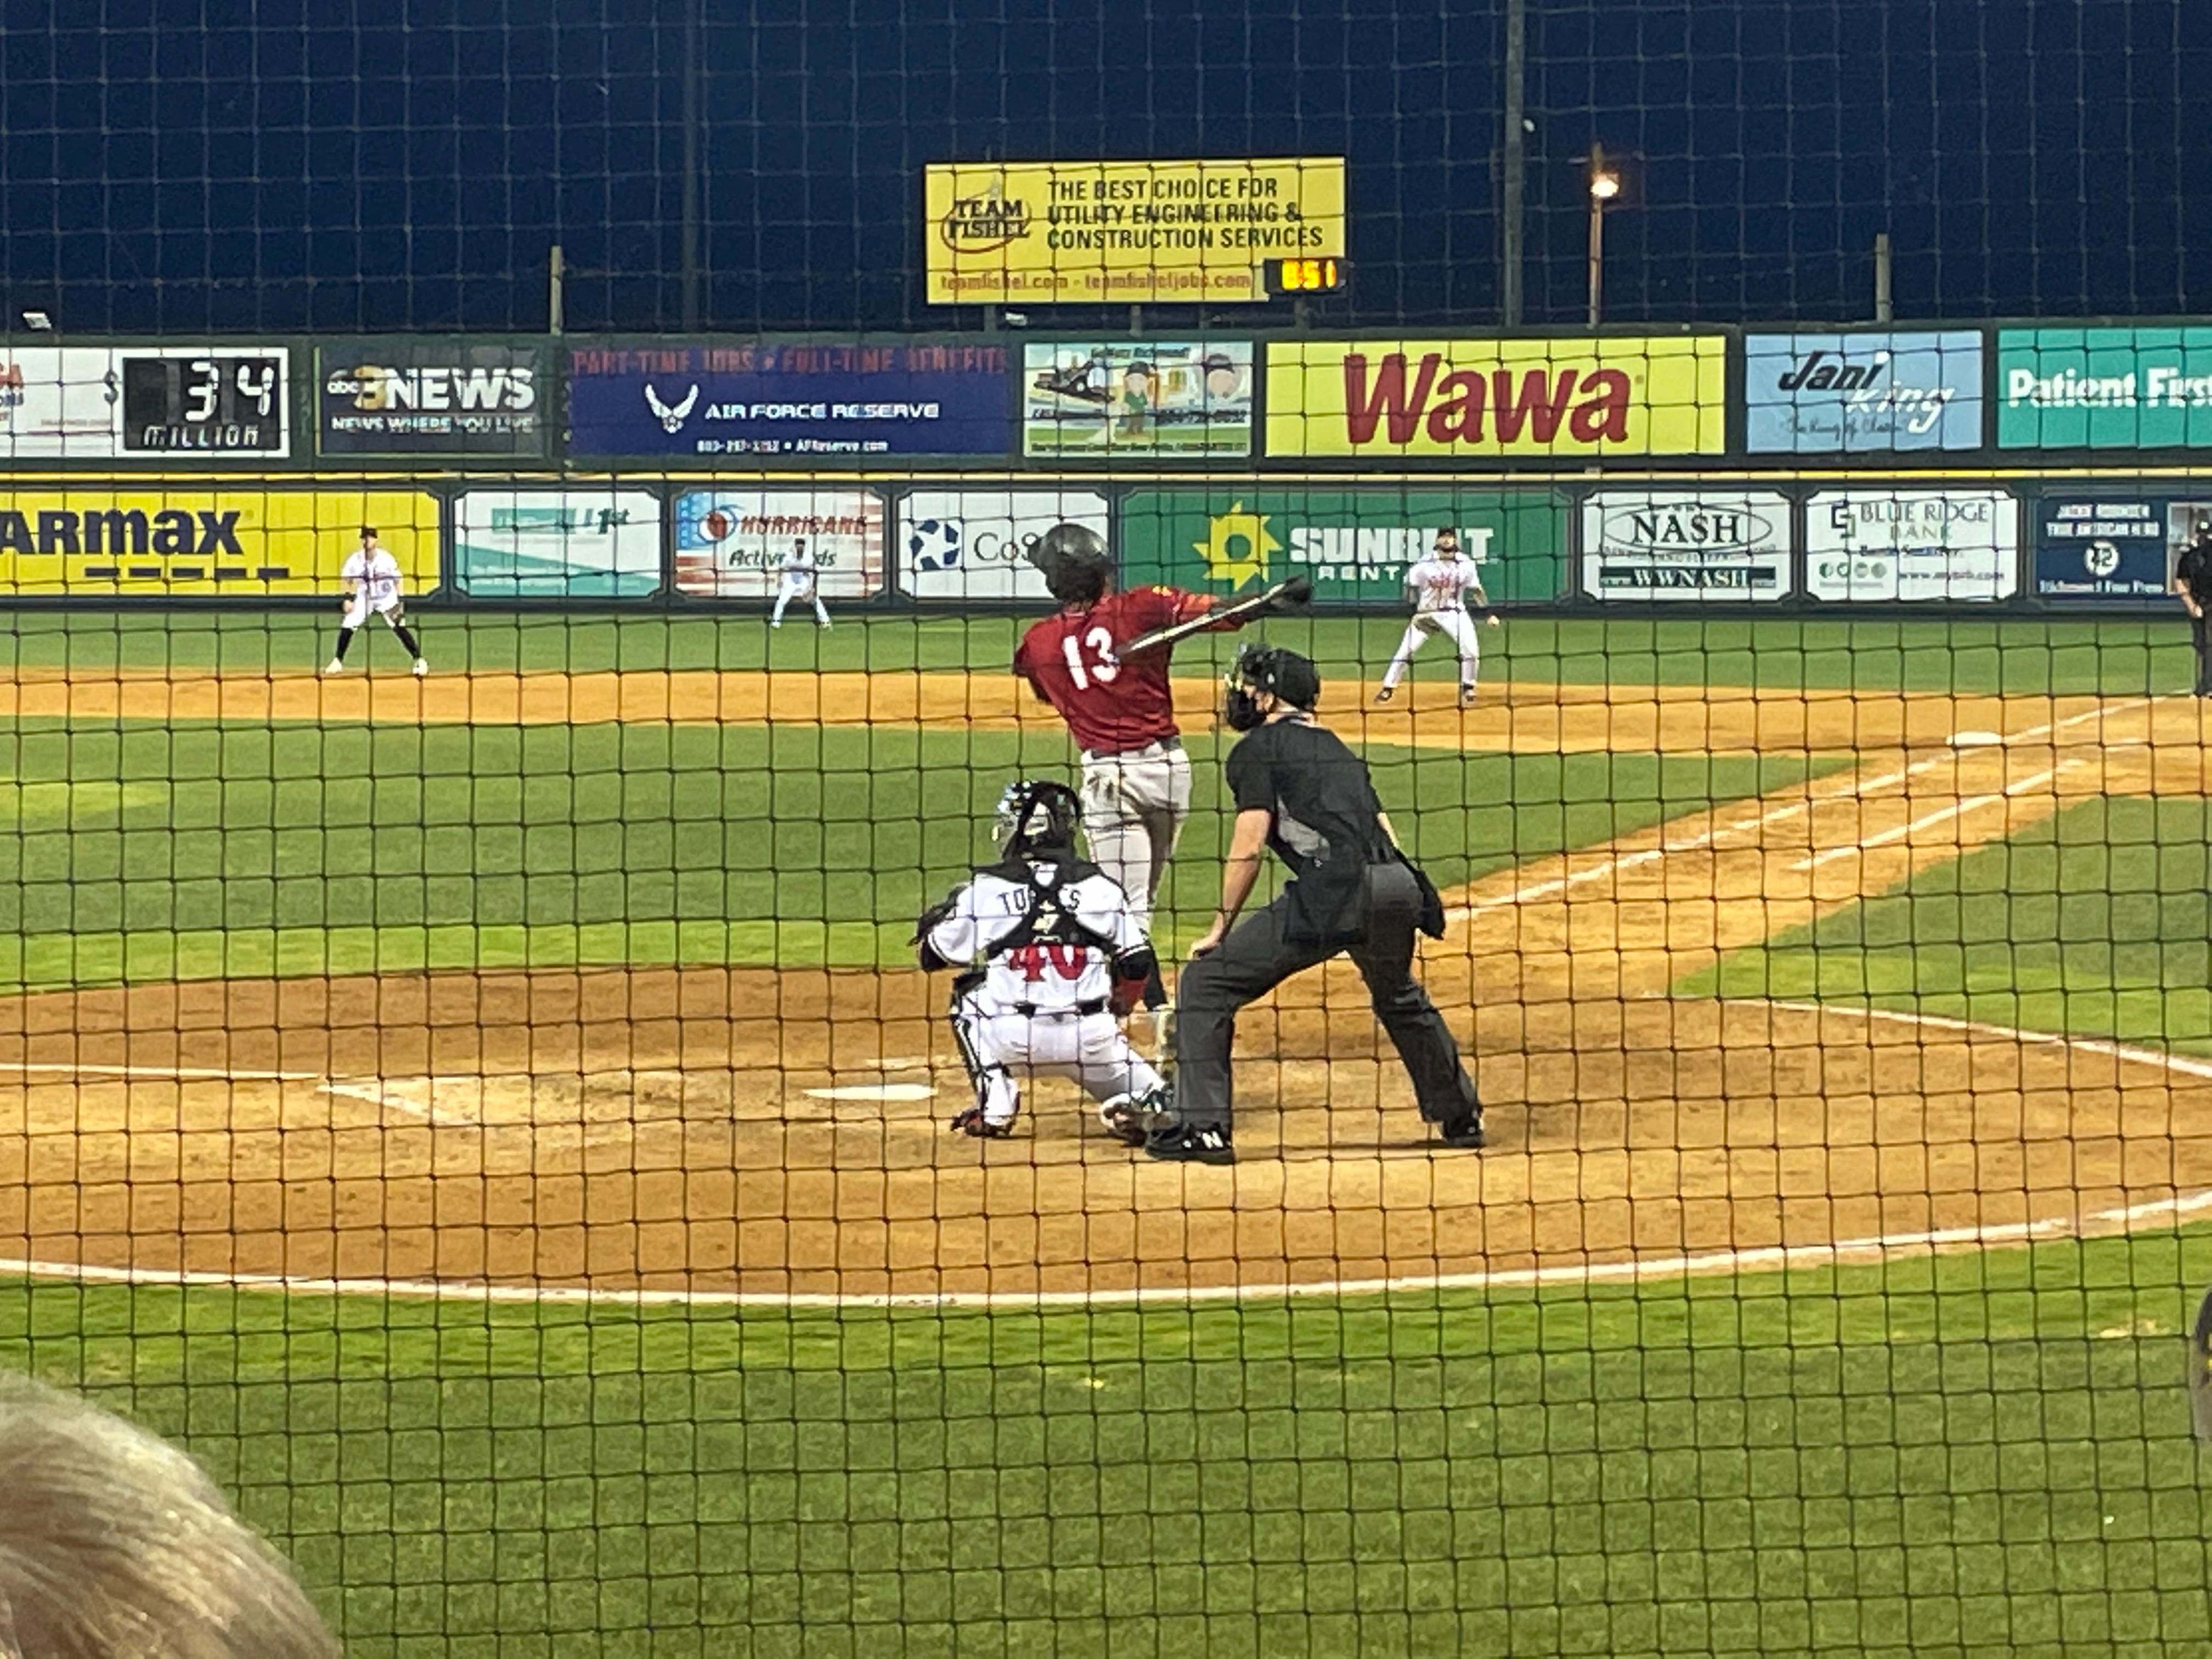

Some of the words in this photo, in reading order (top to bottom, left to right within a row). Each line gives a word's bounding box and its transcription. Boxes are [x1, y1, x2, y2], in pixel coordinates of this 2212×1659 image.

[1048, 180, 1087, 201] THE
[1095, 180, 1147, 200] BEST
[1154, 179, 1231, 199] CHOICE
[1238, 178, 1277, 198] FOR
[955, 200, 1022, 218] TEAM
[1048, 205, 1125, 225] UTILITY
[1133, 202, 1278, 224] ENGINEERING
[1285, 202, 1300, 222] &
[949, 220, 1030, 239] FISHEL
[1048, 229, 1213, 249] CONSTRUCTION
[1221, 226, 1323, 247] SERVICES
[1778, 351, 1891, 391] Jani
[185, 362, 274, 421] 34
[327, 380, 359, 393] abc
[2008, 368, 2137, 408] Patient
[1344, 353, 1630, 444] Wawa
[1847, 380, 1955, 433] King
[705, 404, 746, 419] AIR
[750, 404, 826, 419] FORCE
[832, 403, 939, 418] RESERVE
[1860, 502, 1916, 522] BLUE
[1925, 502, 1989, 522] RIDGE
[1632, 514, 1742, 543] NASH
[1891, 525, 1953, 540] BANK
[1318, 566, 1400, 581] RENT
[1062, 627, 1121, 690] 13
[1008, 944, 1088, 981] 40
